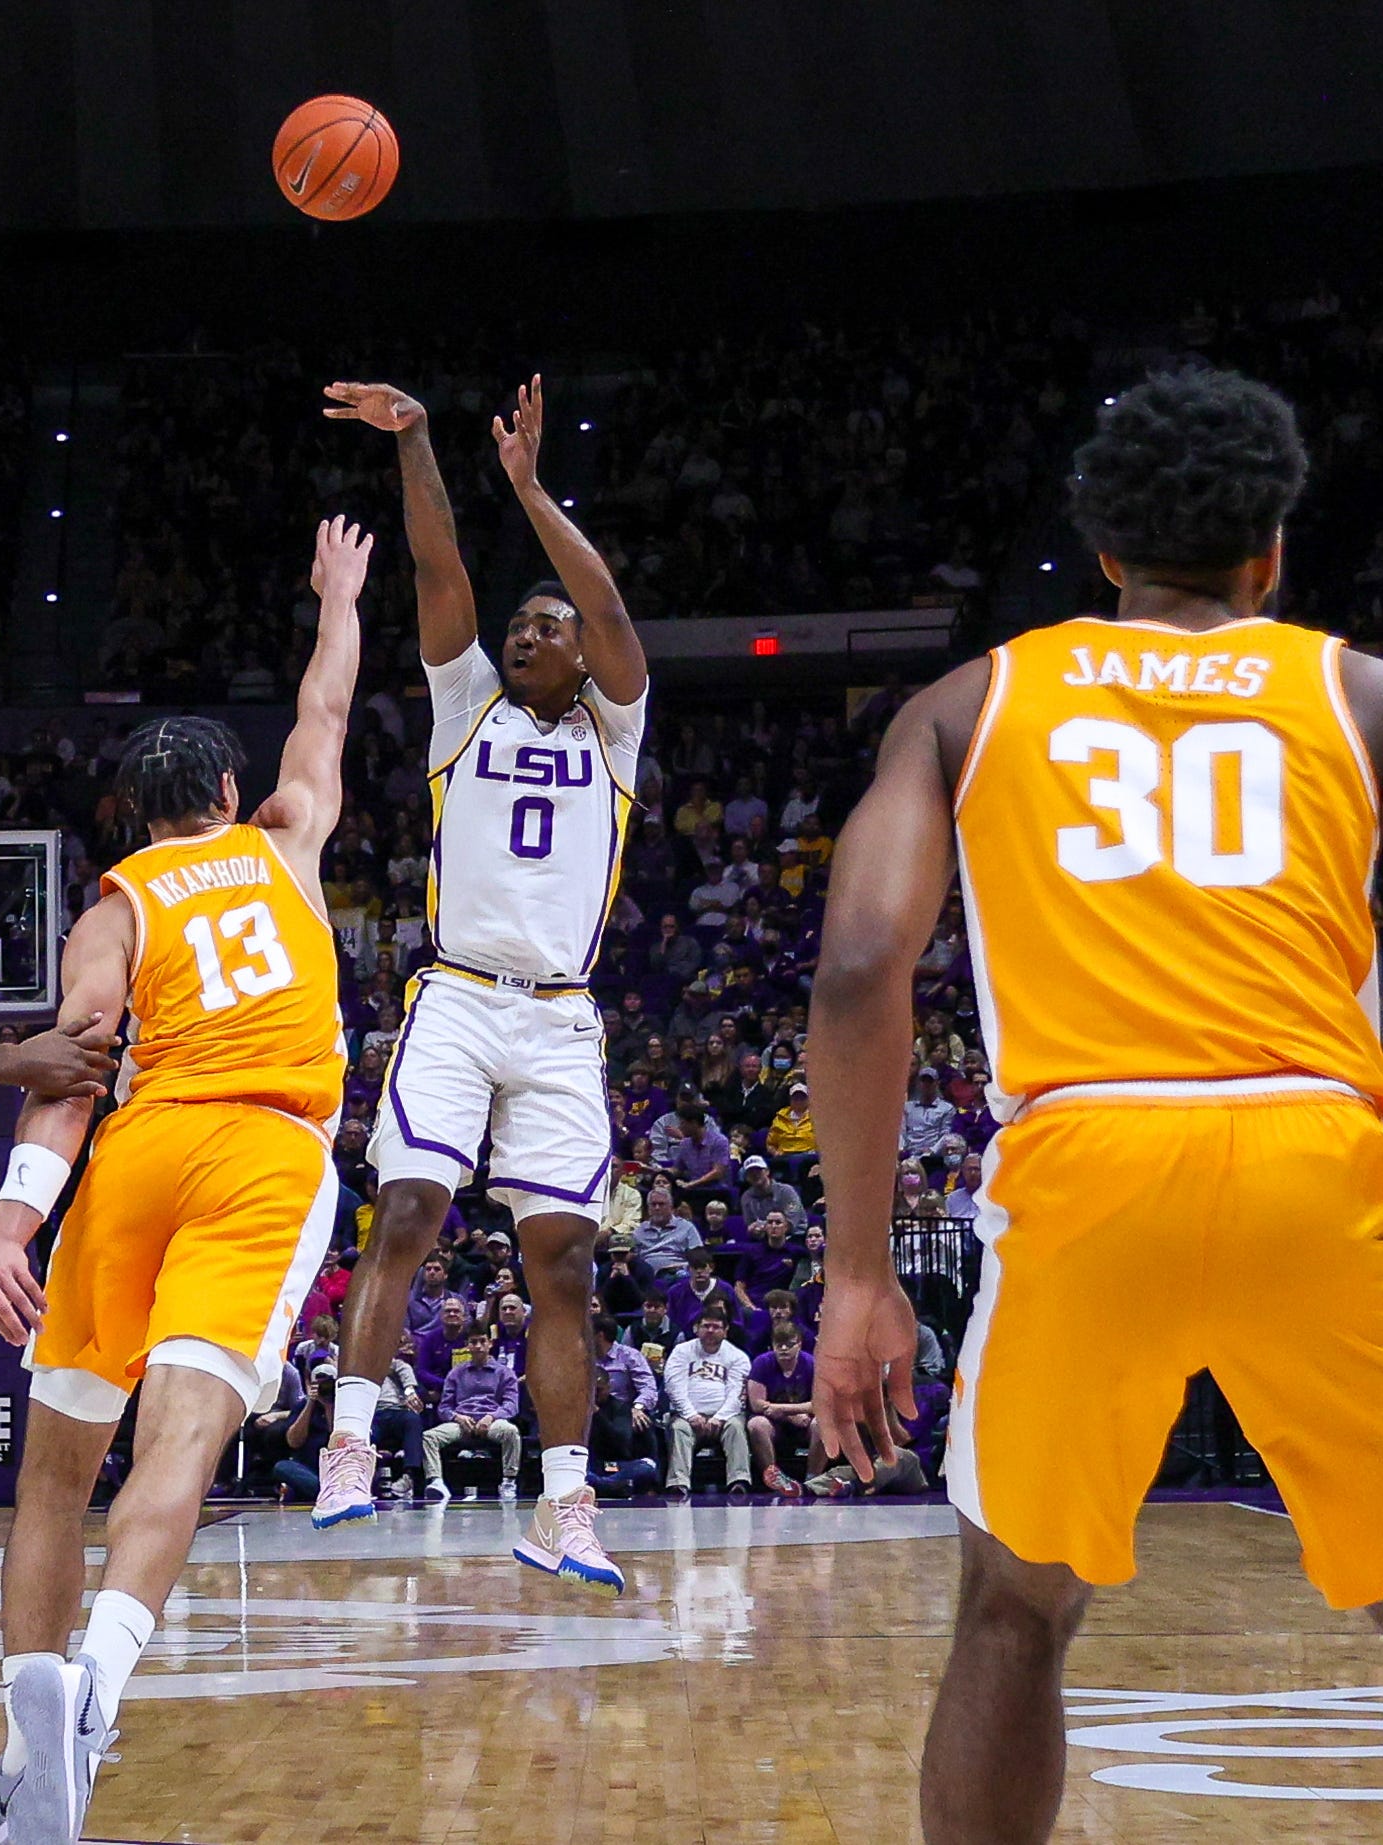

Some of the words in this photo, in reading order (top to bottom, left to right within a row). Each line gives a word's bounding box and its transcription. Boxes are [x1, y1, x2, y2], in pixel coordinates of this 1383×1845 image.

[1063, 647, 1271, 698] JAMES
[475, 739, 593, 788] LSU
[509, 796, 555, 860] 0
[1048, 716, 1285, 888] 30
[146, 855, 272, 909] NKAMHOUA
[183, 900, 294, 1012] 13
[502, 974, 531, 989] LSU
[688, 1360, 729, 1385] LSU
